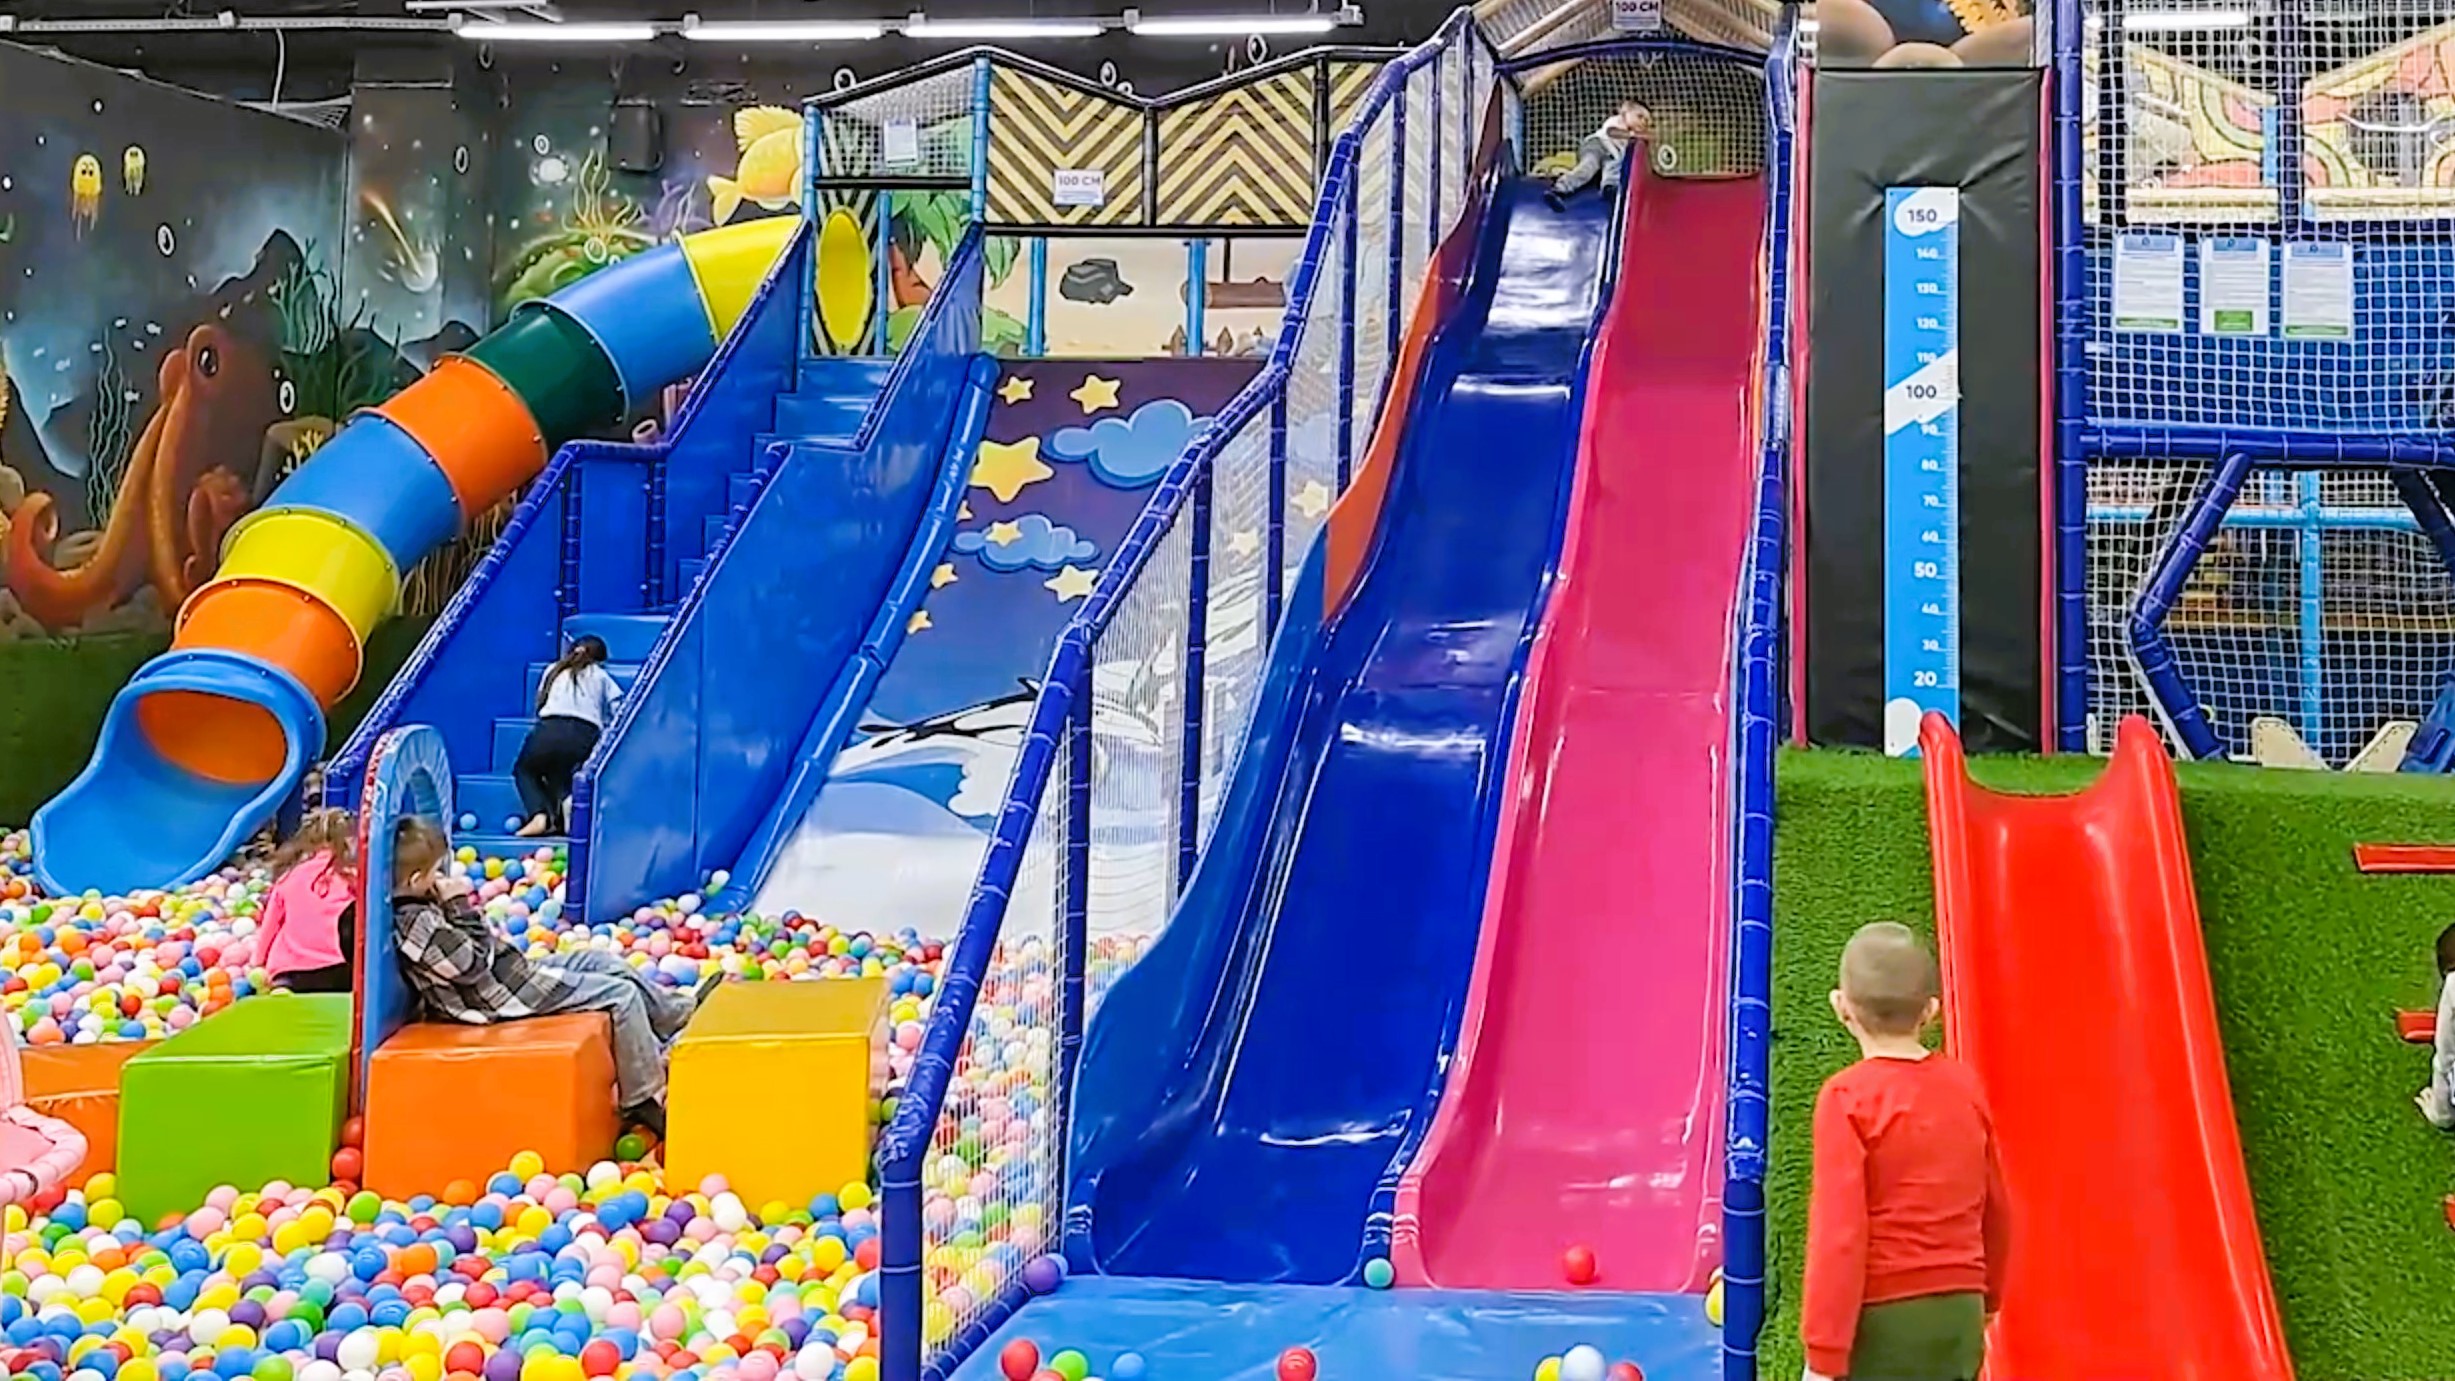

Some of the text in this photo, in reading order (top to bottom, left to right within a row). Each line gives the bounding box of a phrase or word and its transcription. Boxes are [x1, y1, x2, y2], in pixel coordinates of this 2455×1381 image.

[1059, 176, 1079, 186] 100
[1907, 209, 1938, 223] 150
[1916, 247, 1938, 259] 140
[1916, 283, 1938, 294] 130
[1916, 318, 1938, 329] 120
[1906, 385, 1937, 399] 100
[1920, 425, 1938, 436] 90
[1921, 460, 1938, 471] 80
[1922, 495, 1938, 506] 70
[1921, 531, 1938, 542] 60
[1914, 563, 1937, 578] 50
[1921, 604, 1938, 614] 40
[1922, 640, 1938, 651] 30
[1914, 671, 1937, 687] 20
